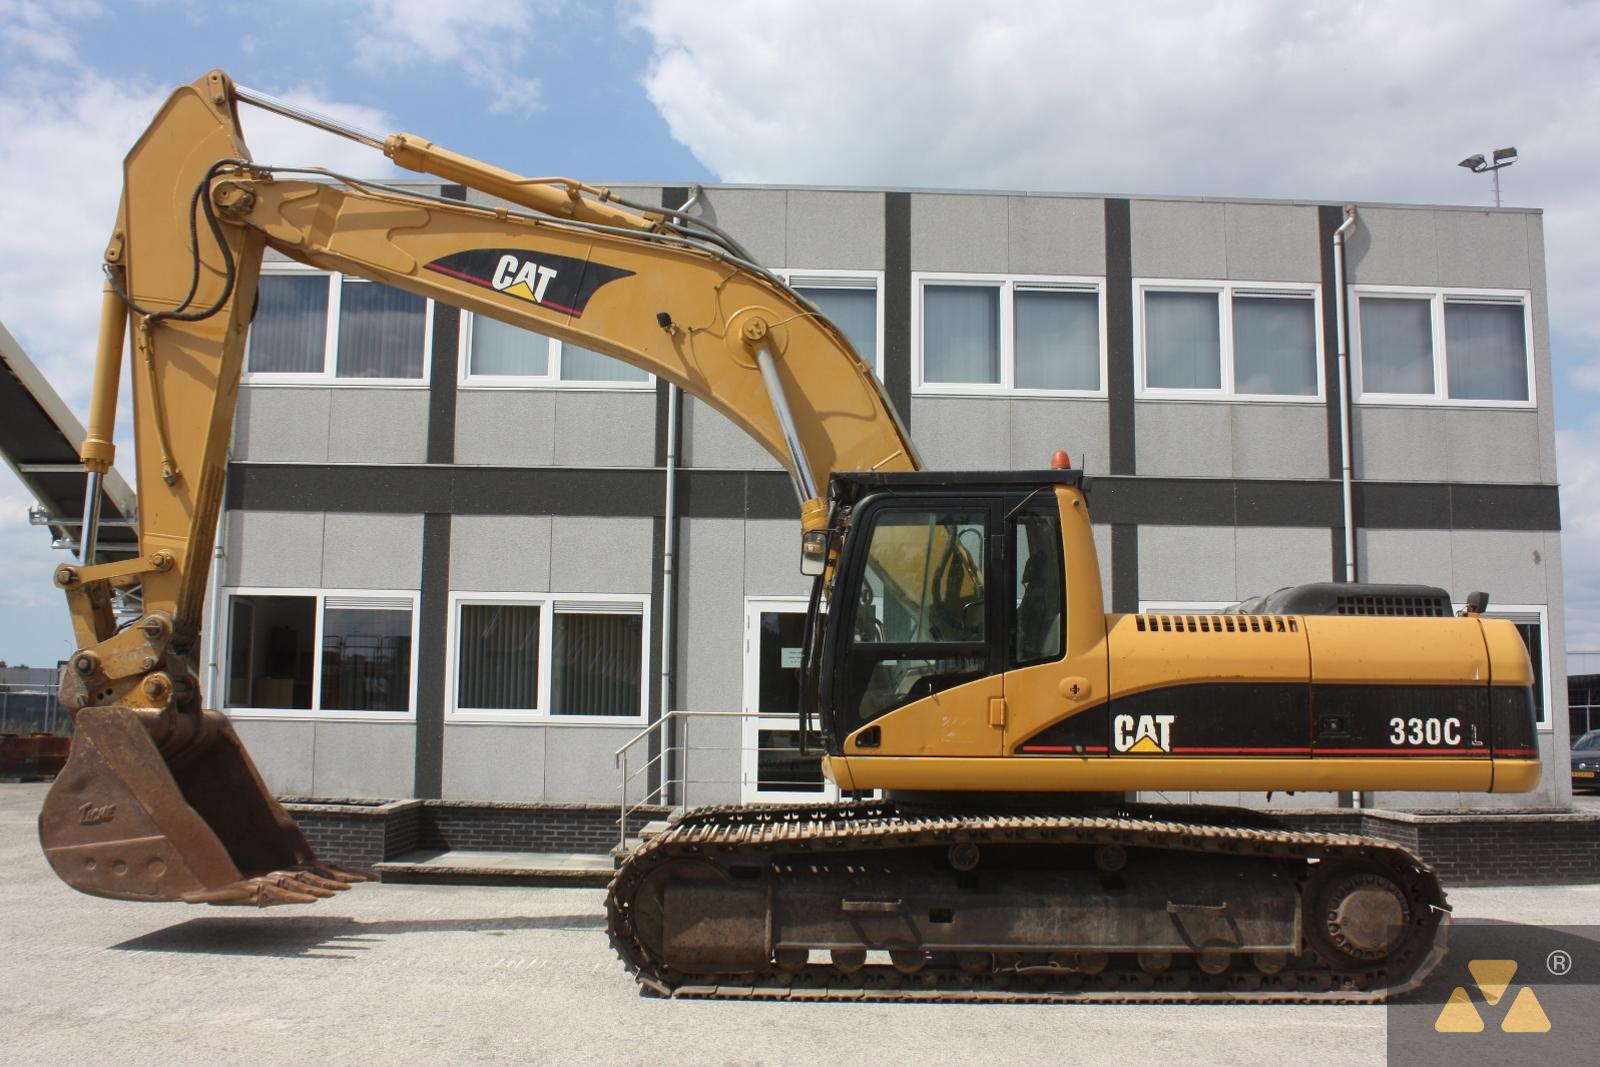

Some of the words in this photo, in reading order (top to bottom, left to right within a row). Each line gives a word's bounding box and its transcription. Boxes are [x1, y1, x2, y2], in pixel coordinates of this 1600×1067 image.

[491, 254, 557, 304] CAT
[1114, 713, 1175, 753] CAT
[1389, 717, 1461, 746] 330C
